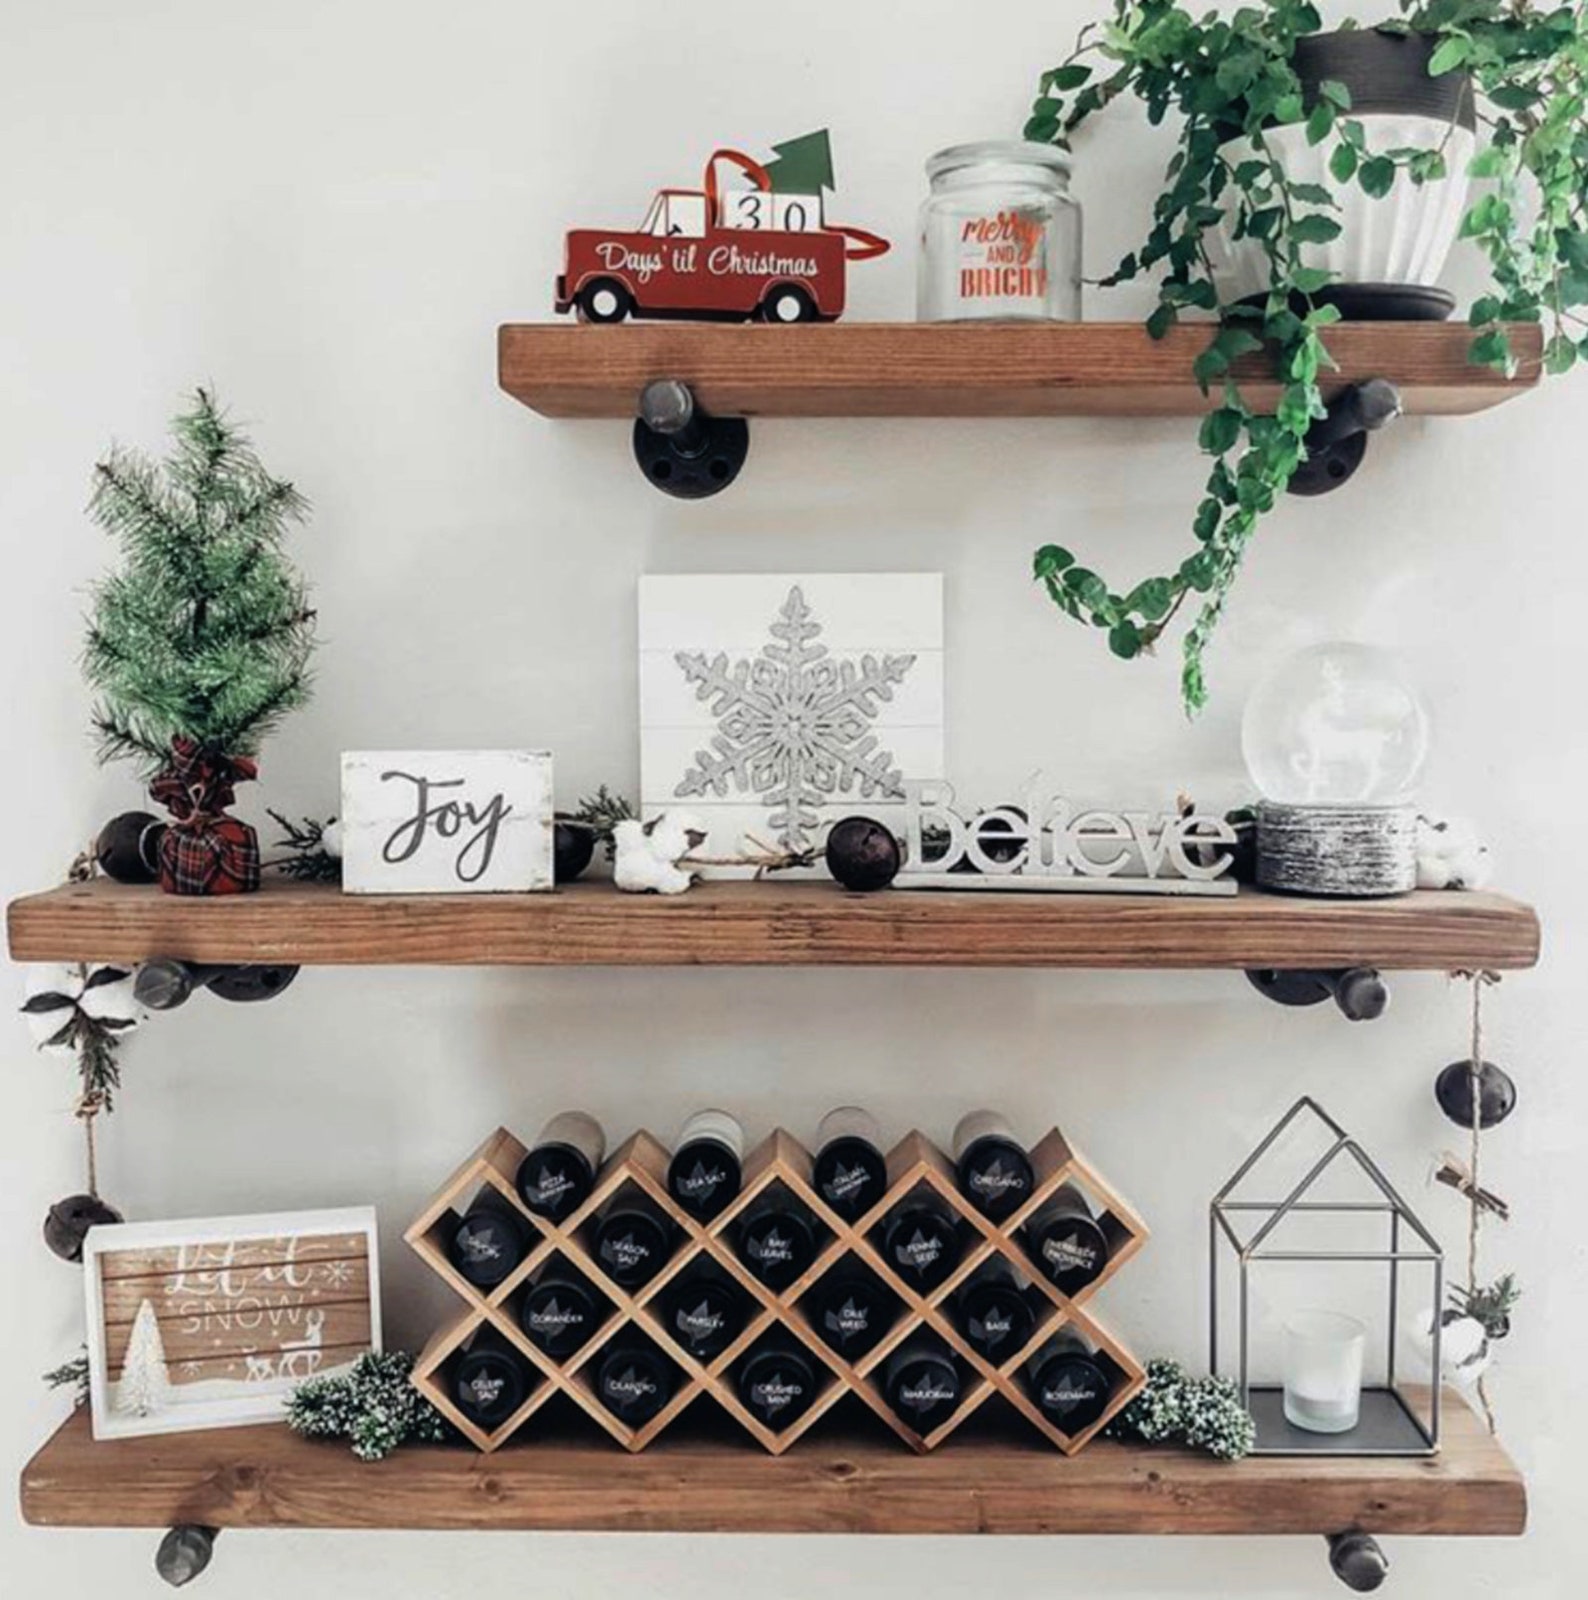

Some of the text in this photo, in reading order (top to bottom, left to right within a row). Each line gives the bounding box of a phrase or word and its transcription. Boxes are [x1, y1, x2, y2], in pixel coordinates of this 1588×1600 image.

[707, 245, 819, 277] Christmas
[986, 244, 1016, 263] AND
[381, 770, 513, 883] Joy
[901, 779, 1239, 882] Believe
[686, 1171, 727, 1189] SEA SALT
[974, 1174, 1023, 1189] OREGANO
[612, 1240, 650, 1257] SEASON
[760, 1248, 792, 1260] LEAVES
[178, 1293, 304, 1334] SNOW
[530, 1312, 583, 1325] CORIANDER
[686, 1316, 725, 1329] PARSLEY
[840, 1318, 868, 1330] WEED
[757, 1383, 803, 1395] CRUSHED
[1044, 1390, 1096, 1401] ROSEMARY
